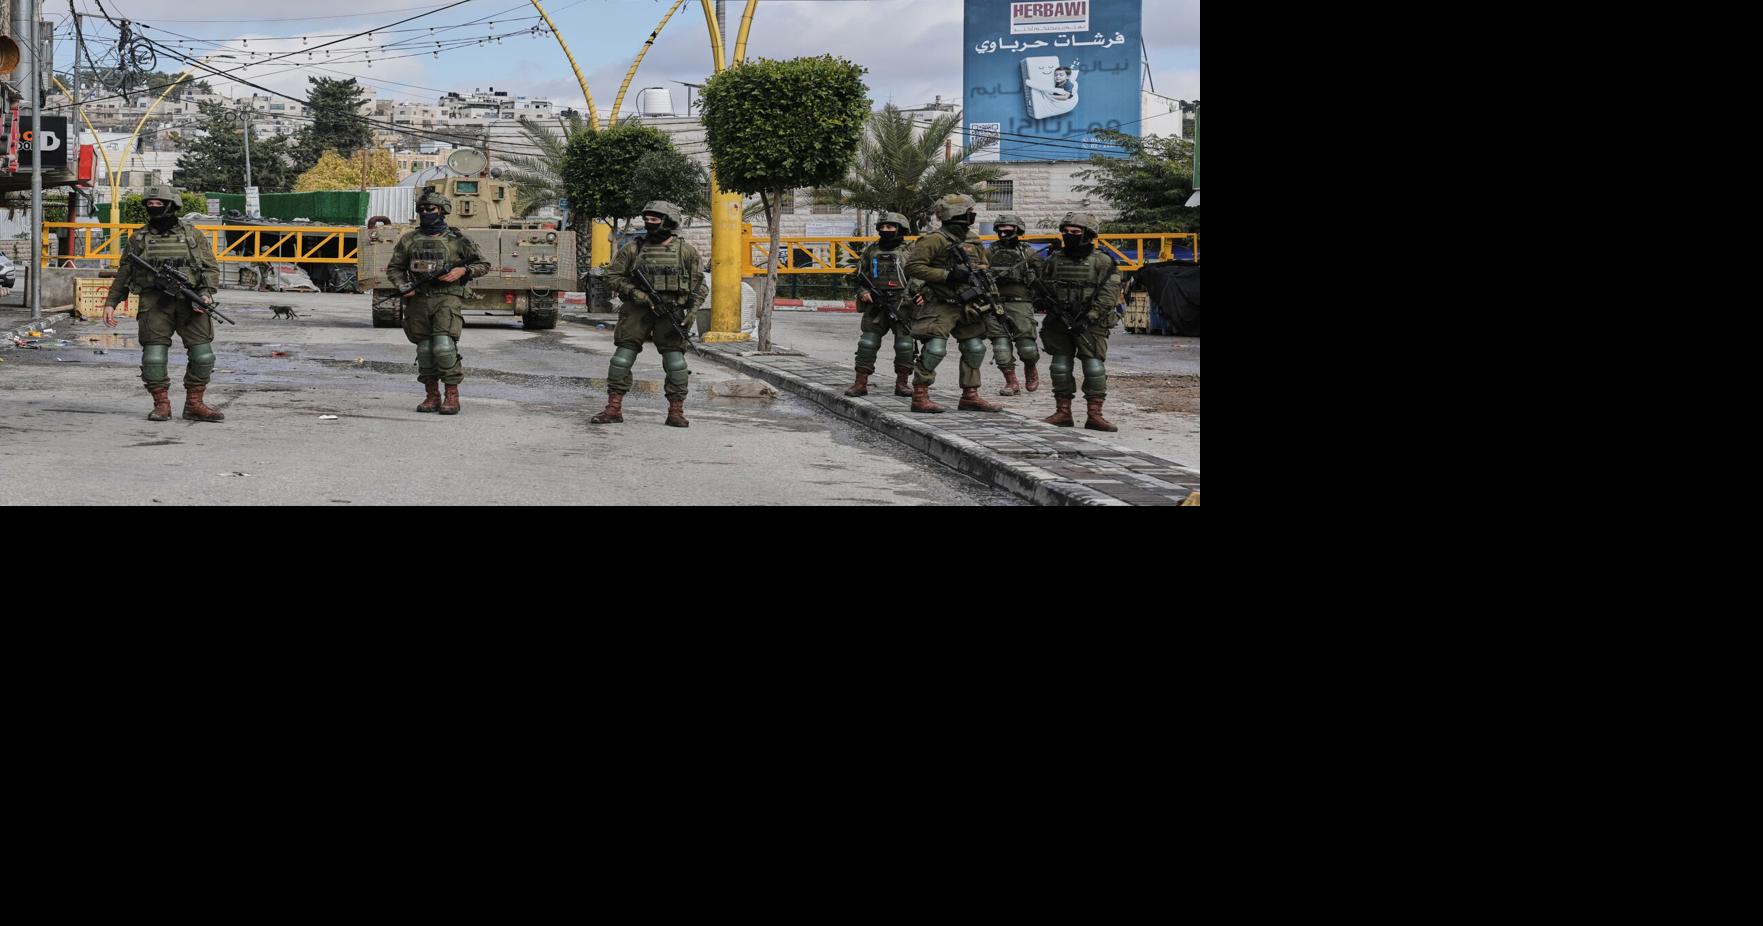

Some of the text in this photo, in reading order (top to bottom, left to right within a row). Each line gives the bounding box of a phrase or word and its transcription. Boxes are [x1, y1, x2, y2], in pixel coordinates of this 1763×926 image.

[1013, 1, 1087, 18] HERBAWI
[975, 31, 1125, 54] فرشات حرباوي
